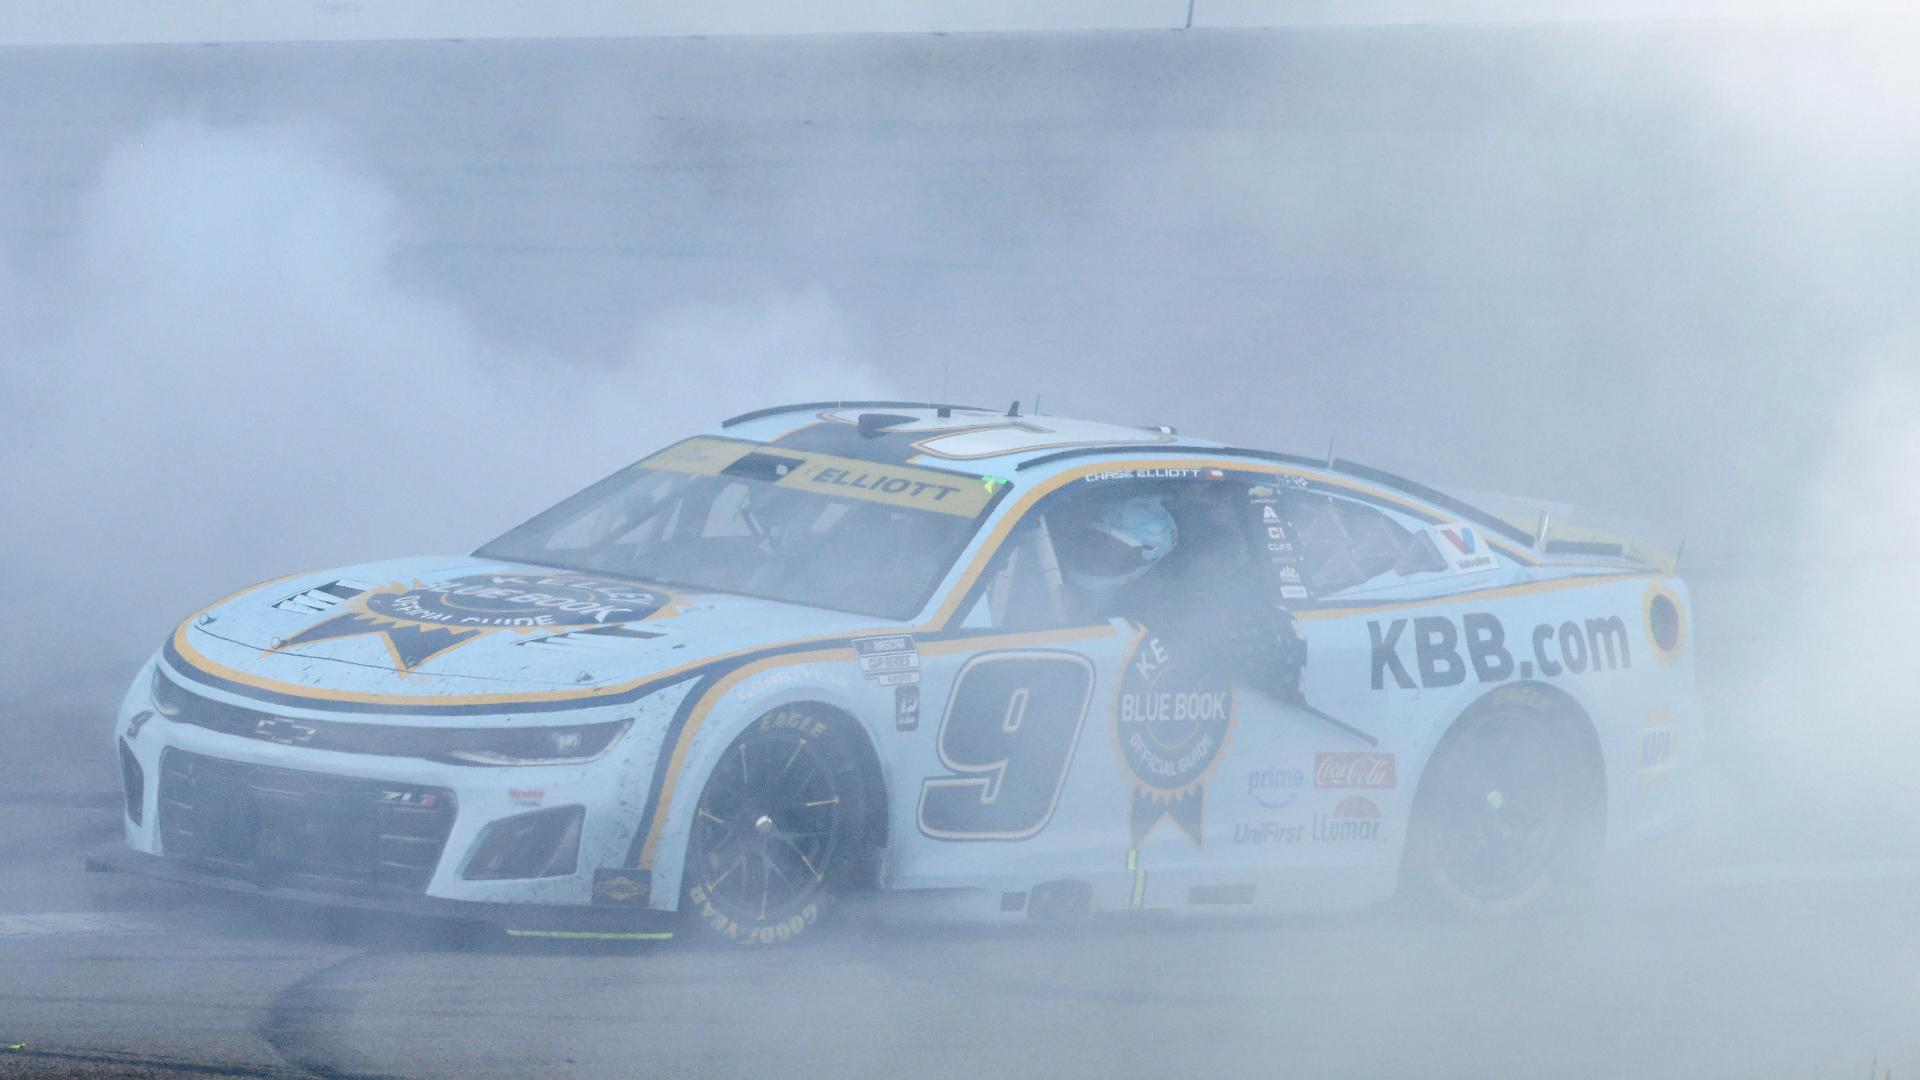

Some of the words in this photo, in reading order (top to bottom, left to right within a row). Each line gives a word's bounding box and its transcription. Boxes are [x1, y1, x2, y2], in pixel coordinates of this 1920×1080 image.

[812, 467, 961, 500] ELLIOTT
[1086, 471, 1134, 482] CHASE
[1136, 468, 1200, 479] ELLIOTT
[504, 592, 634, 623] BOOK
[1366, 611, 1632, 690] KBB.com
[1121, 692, 1171, 722] BLUE
[1174, 690, 1227, 721] BOOK
[757, 710, 829, 739] EAGLE
[916, 648, 1097, 842] 9
[1178, 731, 1215, 773] GUIDE
[1247, 764, 1304, 795] prime
[1233, 821, 1305, 845] UniFirst
